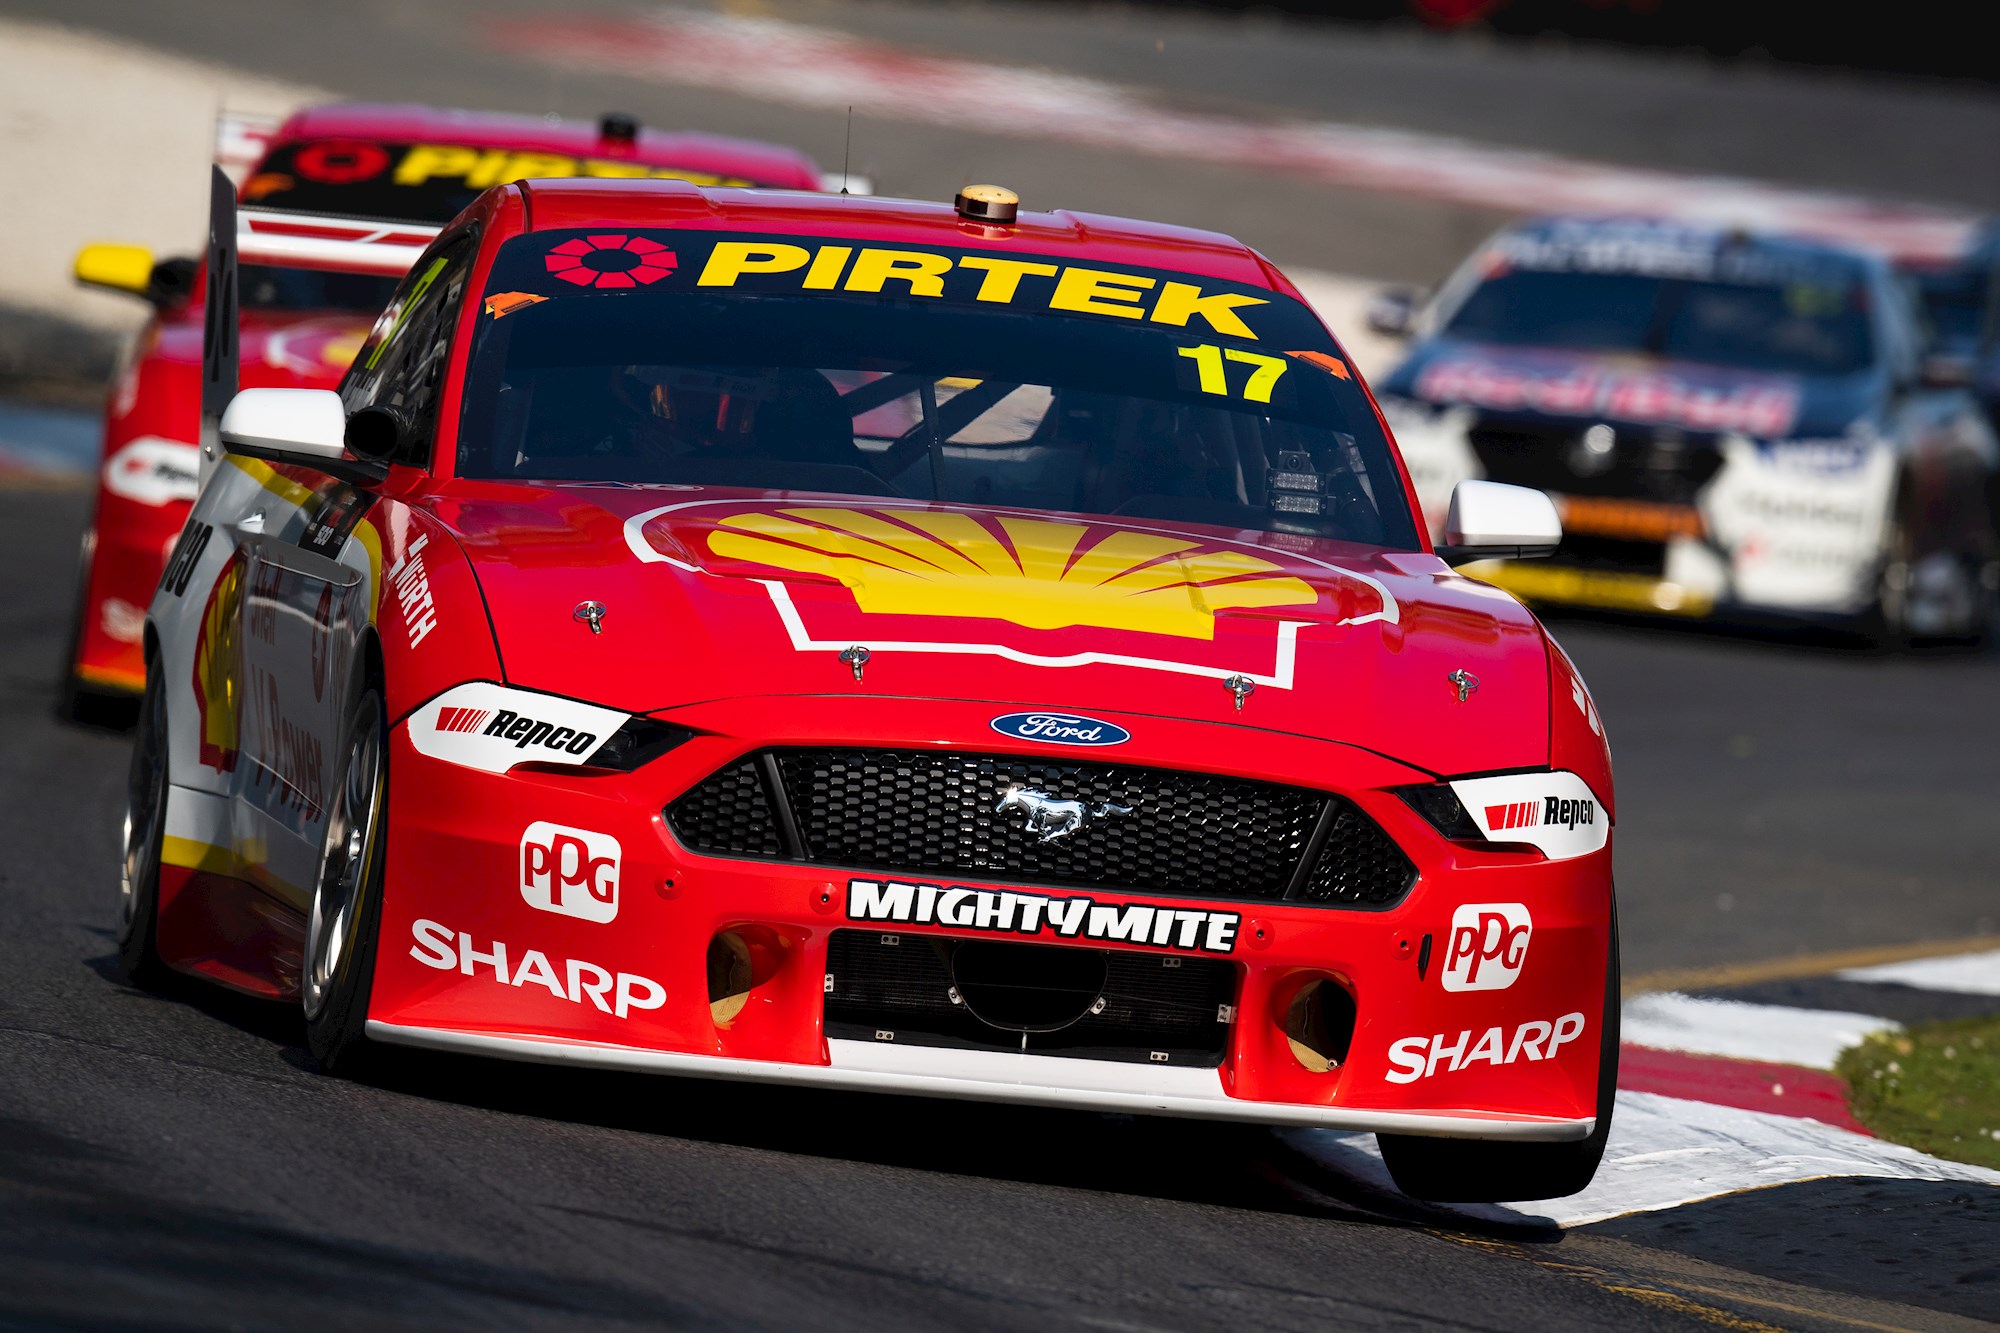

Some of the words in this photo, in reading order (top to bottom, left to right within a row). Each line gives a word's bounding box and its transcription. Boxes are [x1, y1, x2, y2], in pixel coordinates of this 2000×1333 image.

[697, 242, 1269, 341] PIRTEK
[1177, 345, 1288, 404] 17
[395, 552, 437, 650] WÜRTH
[482, 708, 597, 756] Repco
[1017, 713, 1102, 743] Ford
[1544, 796, 1594, 831] Repco
[524, 833, 616, 907] PPG
[409, 918, 667, 1019] SHARP
[1447, 912, 1529, 984] PPG
[1384, 1011, 1586, 1085] SHARP
